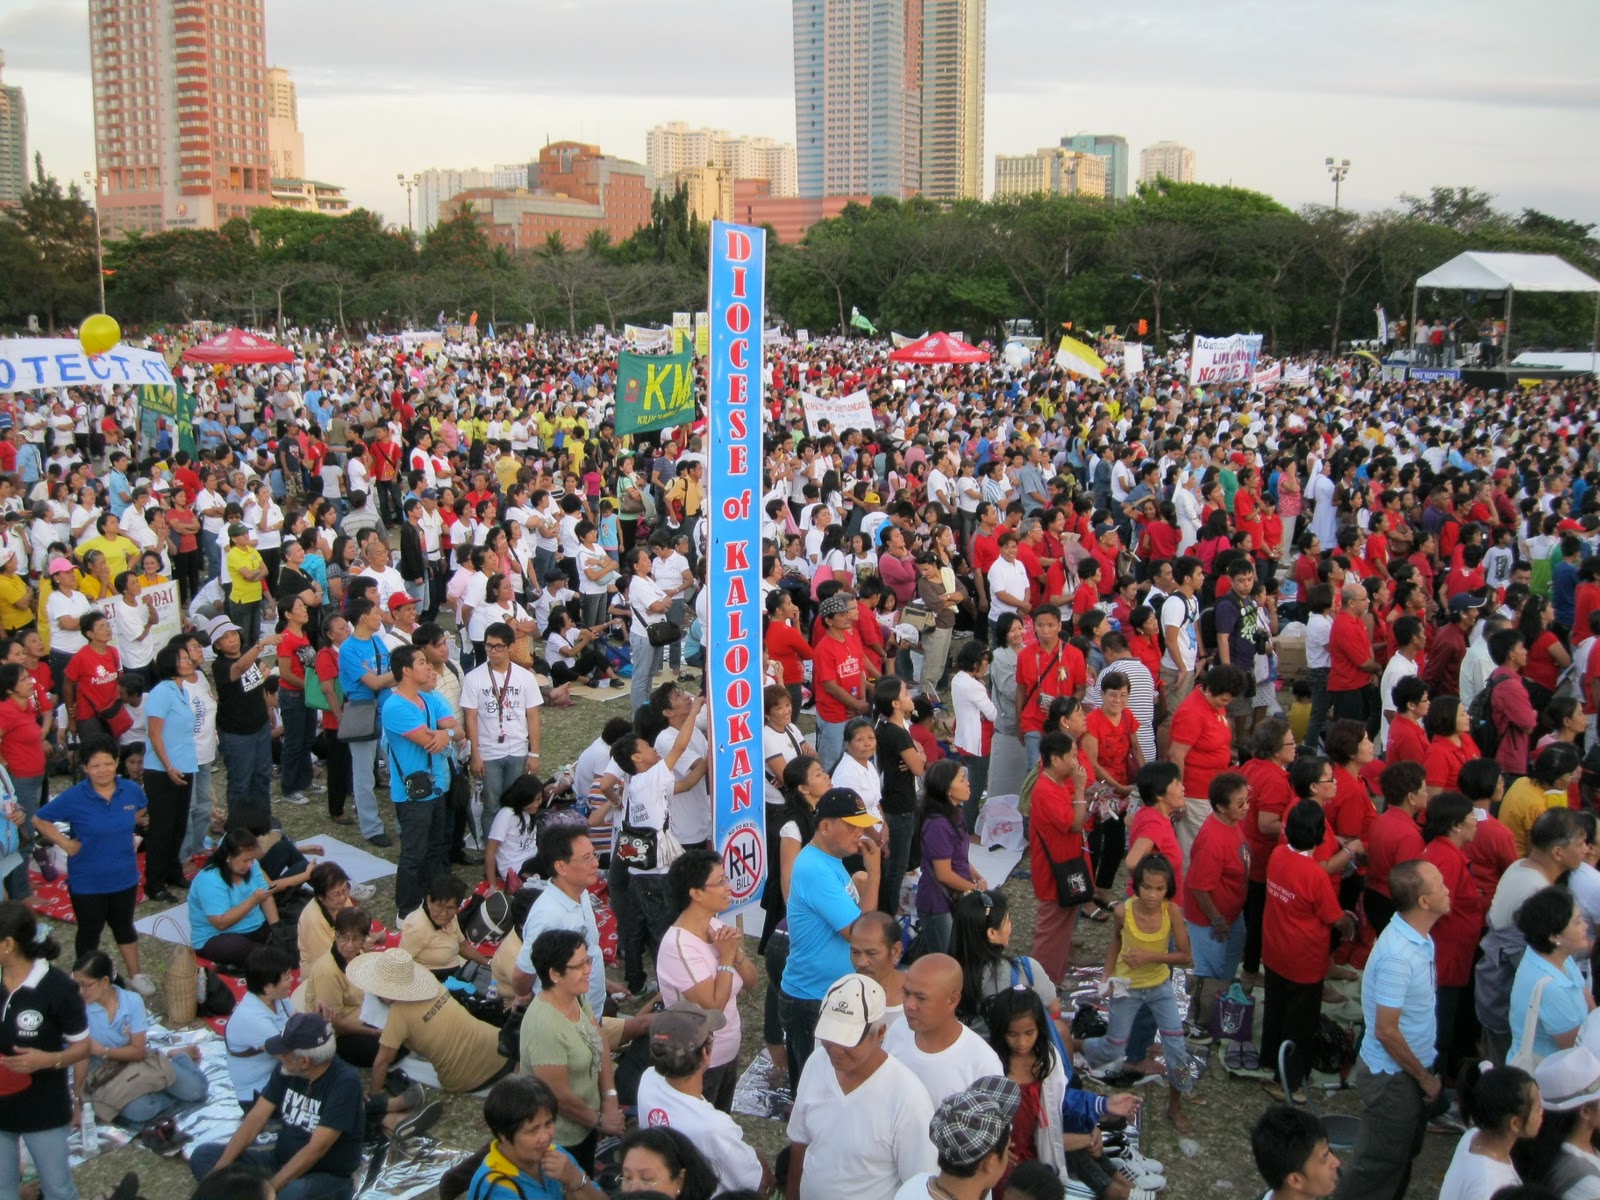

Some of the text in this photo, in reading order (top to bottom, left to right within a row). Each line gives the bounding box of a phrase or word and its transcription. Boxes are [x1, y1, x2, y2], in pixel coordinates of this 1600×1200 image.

[723, 230, 753, 813] DIOCESE of KALOOKAN
[241, 670, 264, 687] LIFE
[728, 838, 757, 880] RH
[736, 876, 752, 891] BILL
[281, 1101, 321, 1132] LIFE
